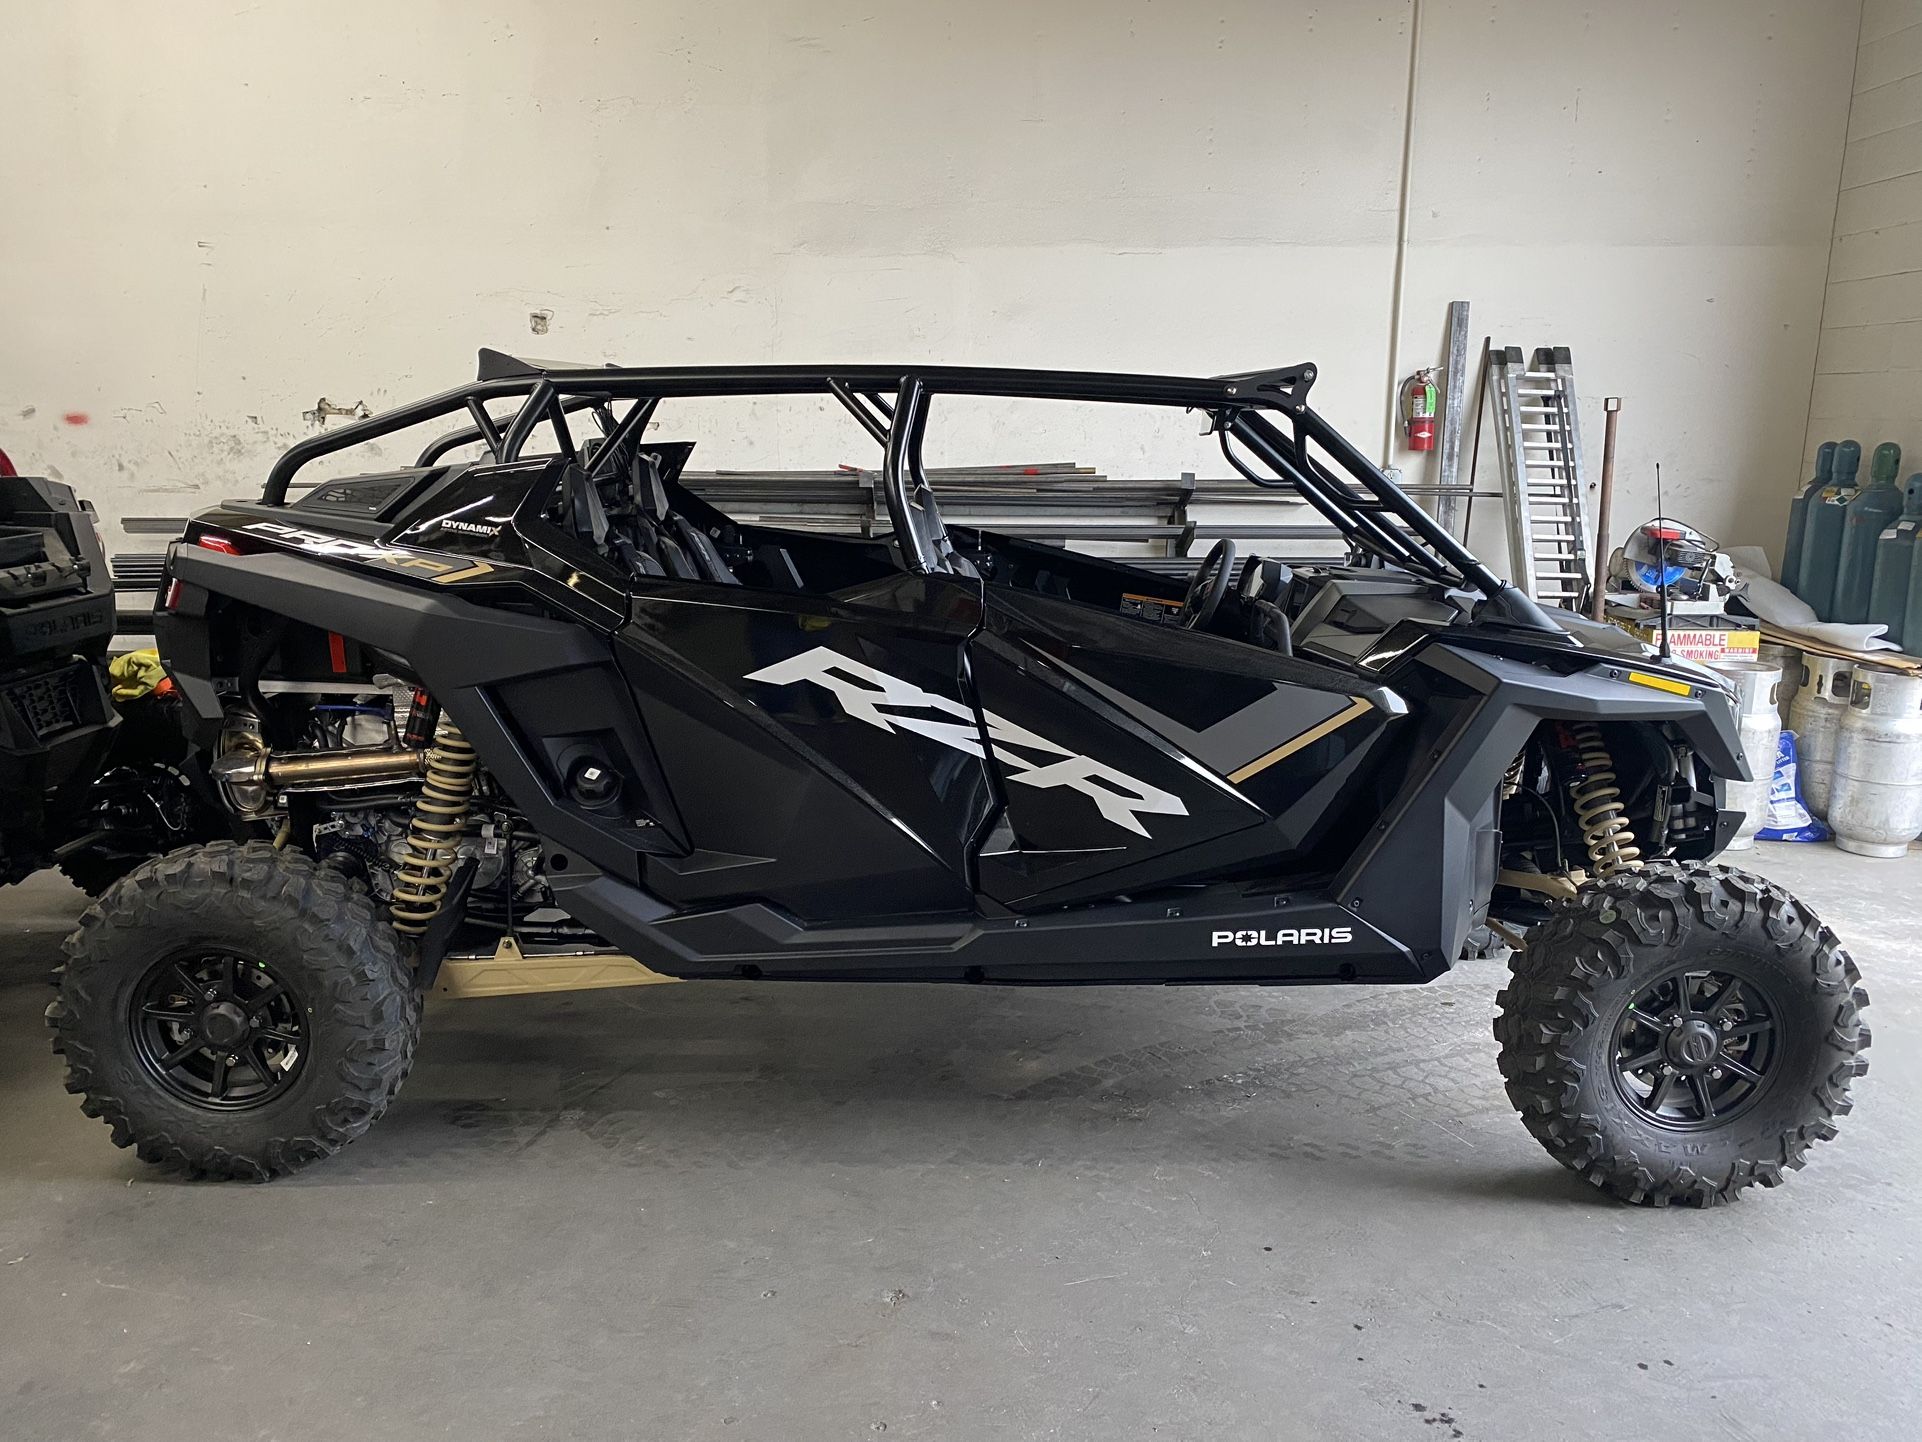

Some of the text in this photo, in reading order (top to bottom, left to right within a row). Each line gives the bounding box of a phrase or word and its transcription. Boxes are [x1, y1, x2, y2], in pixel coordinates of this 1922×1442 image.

[441, 519, 502, 536] DYNAMIX
[1655, 633, 1726, 647] FAMMABLE
[1680, 649, 1719, 660] SMOKING
[743, 646, 1189, 839] RZR
[1211, 927, 1353, 947] POLARIS
